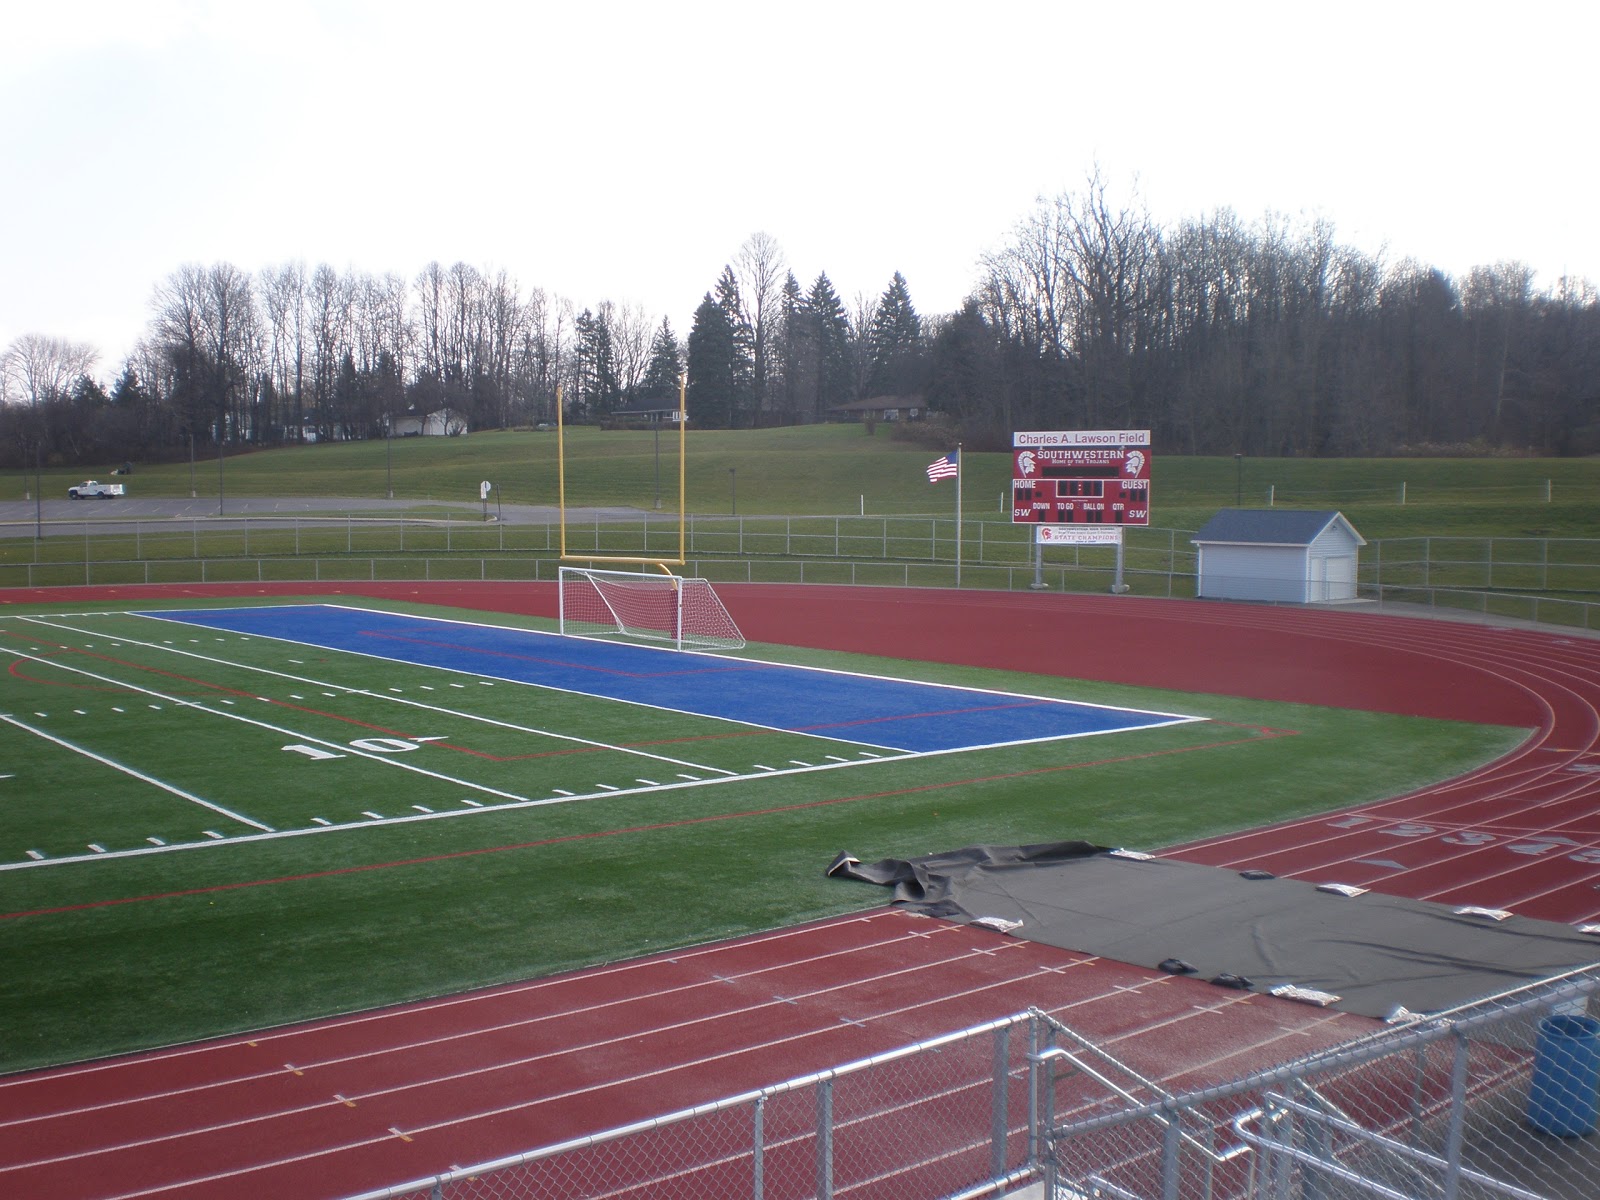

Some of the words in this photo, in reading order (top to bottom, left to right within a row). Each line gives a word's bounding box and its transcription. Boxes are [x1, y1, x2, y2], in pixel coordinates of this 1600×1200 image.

[1019, 434, 1058, 444] Charles
[1061, 434, 1072, 444] A.
[1075, 434, 1116, 443] Lawson
[1119, 433, 1145, 443] Field
[1037, 450, 1125, 459] SOUTHWESTERN
[1014, 480, 1036, 489] HOME
[1122, 480, 1147, 489] GUEST
[1032, 502, 1050, 510] DOWN
[1057, 502, 1065, 510] TO
[1065, 502, 1074, 510] GO
[1083, 502, 1096, 510] BALL
[1096, 502, 1105, 510] ON
[1112, 502, 1125, 510] QTR
[1014, 508, 1031, 517] SW
[1128, 510, 1147, 518] SW
